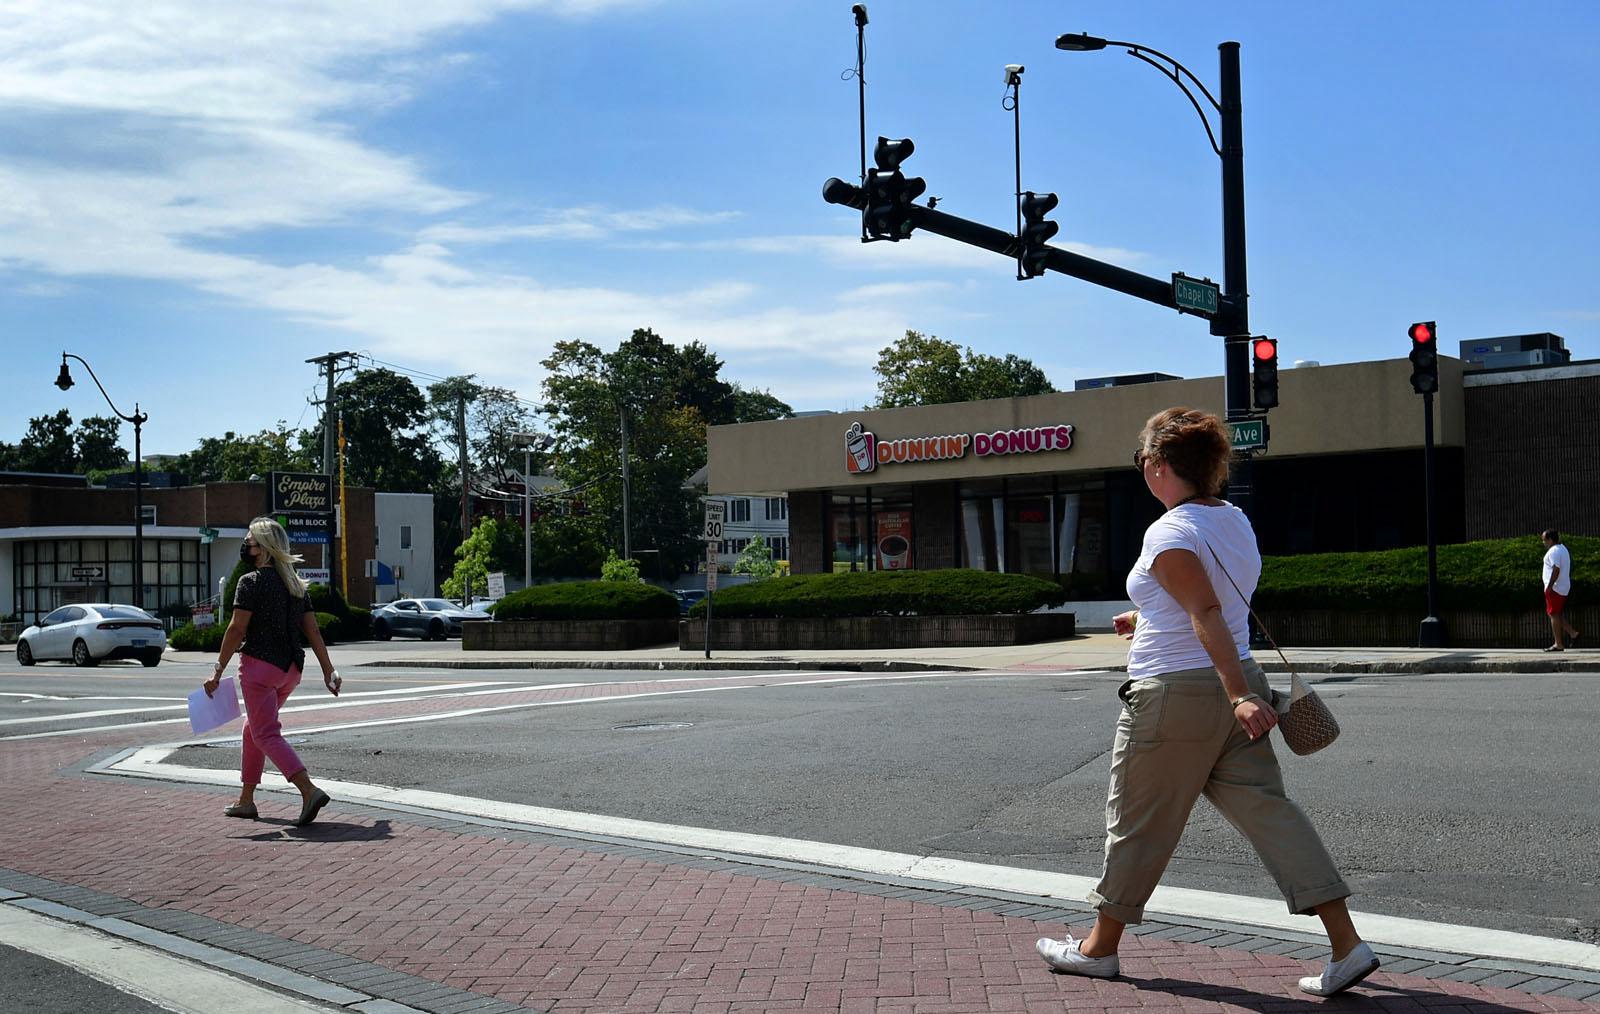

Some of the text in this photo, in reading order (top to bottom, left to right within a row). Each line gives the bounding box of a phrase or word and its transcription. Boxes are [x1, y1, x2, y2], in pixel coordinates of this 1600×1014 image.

[1177, 282, 1216, 306] Chapel St
[1234, 427, 1258, 443] Ave
[877, 425, 1070, 464] DUNKIN' DONUTS
[278, 475, 326, 493] Empire
[283, 490, 326, 509] Plaza
[706, 503, 724, 513] SPEED
[706, 521, 721, 538] 30
